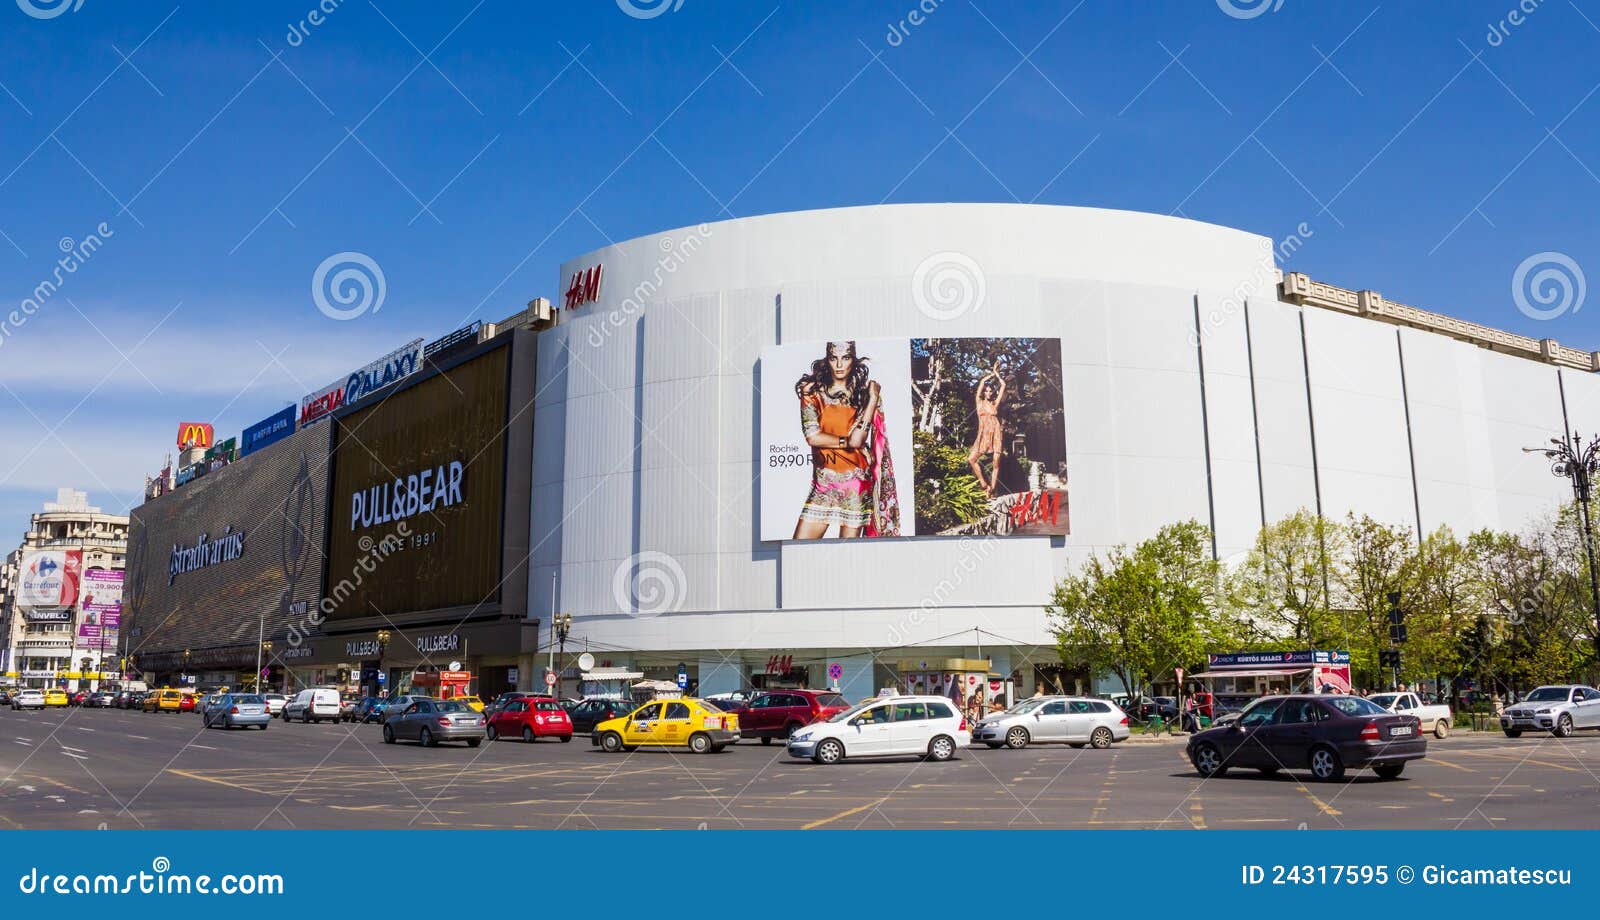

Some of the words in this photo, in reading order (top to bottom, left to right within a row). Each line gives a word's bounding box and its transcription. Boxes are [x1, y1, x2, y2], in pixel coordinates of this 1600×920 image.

[565, 264, 603, 311] H&M
[770, 445, 798, 453] Rochie
[770, 454, 804, 468] 89,90
[351, 460, 463, 531] PULL&BEAR
[1010, 491, 1062, 527] H&M
[417, 634, 458, 652] PULL&BEAR
